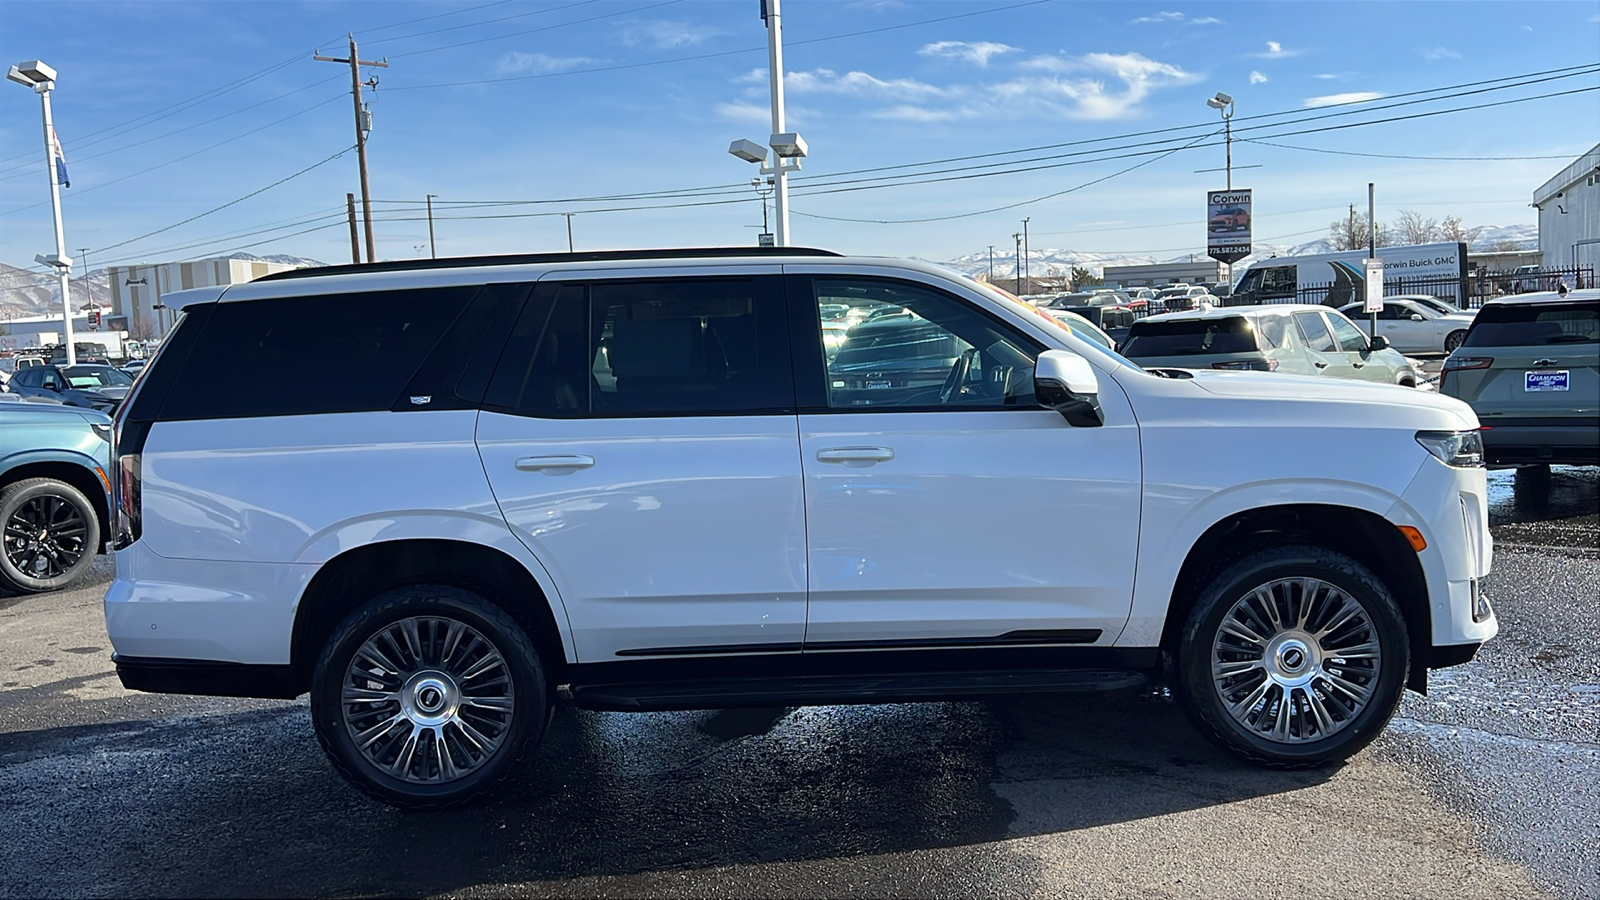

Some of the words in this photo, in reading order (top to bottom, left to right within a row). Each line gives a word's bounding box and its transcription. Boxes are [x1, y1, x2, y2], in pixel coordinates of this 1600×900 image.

[1213, 193, 1251, 204] Corwin
[1384, 261, 1408, 269] orwin
[1409, 259, 1433, 268] Buick
[1434, 256, 1455, 266] GMC
